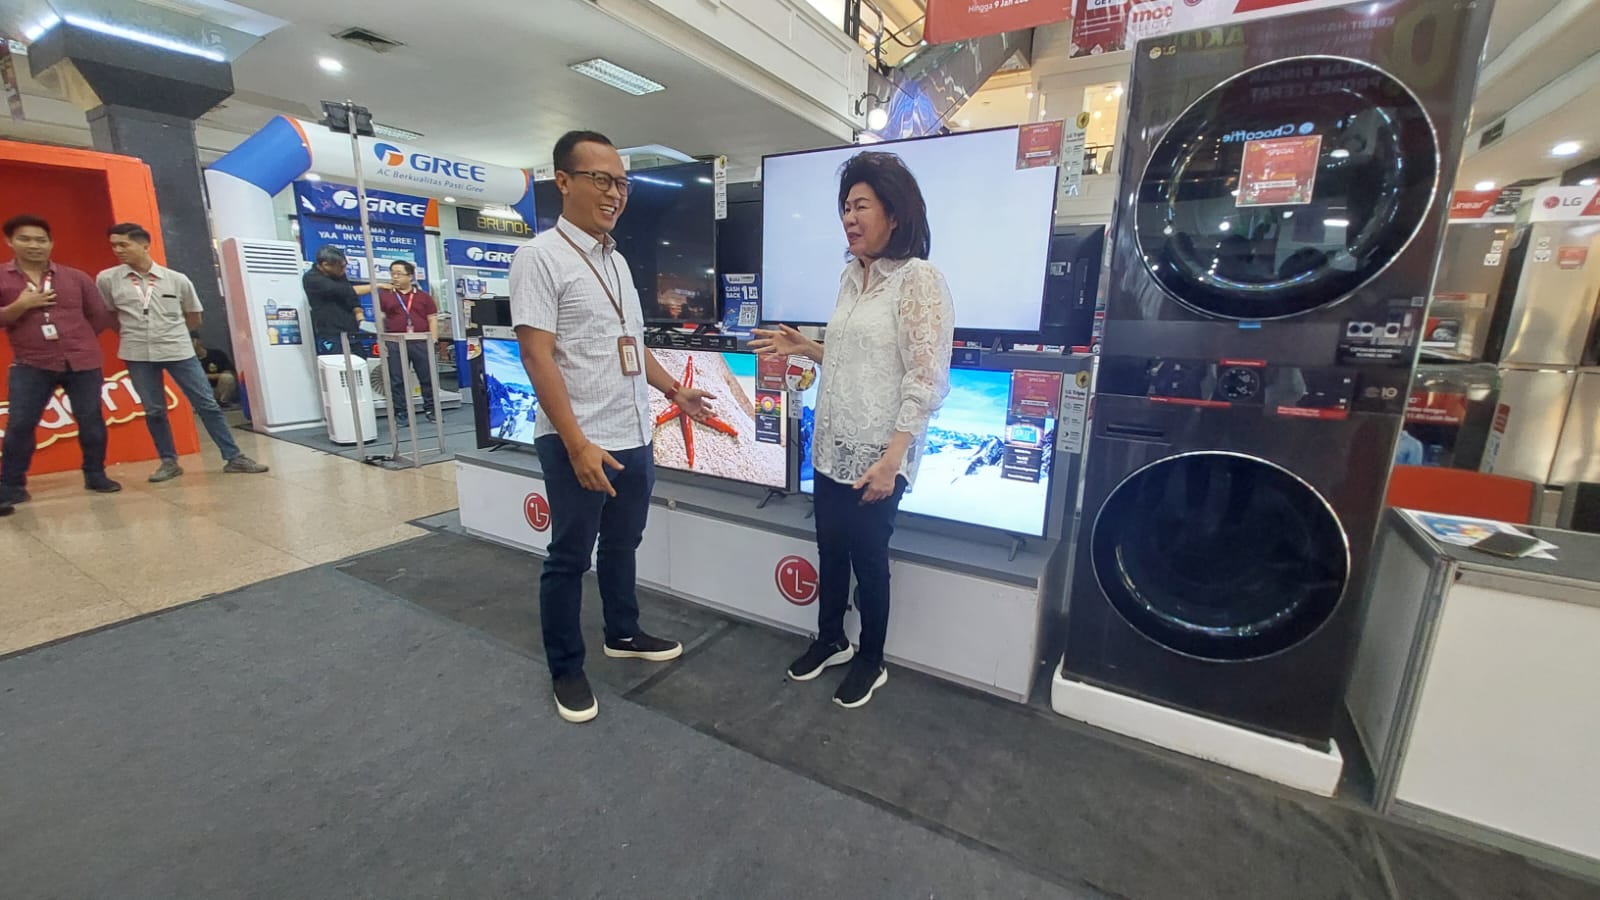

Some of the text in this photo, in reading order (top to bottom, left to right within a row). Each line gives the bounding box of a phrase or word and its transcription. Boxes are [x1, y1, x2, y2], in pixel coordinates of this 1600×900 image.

[968, 4, 993, 13] Hingga
[410, 153, 486, 183] GREE
[377, 168, 485, 193] AC Berkualitas Pasti Gree
[365, 197, 426, 218] GREE
[1562, 197, 1582, 207] LG
[318, 231, 338, 239] YAA
[343, 233, 386, 243] INVETER
[484, 251, 514, 263] GRE
